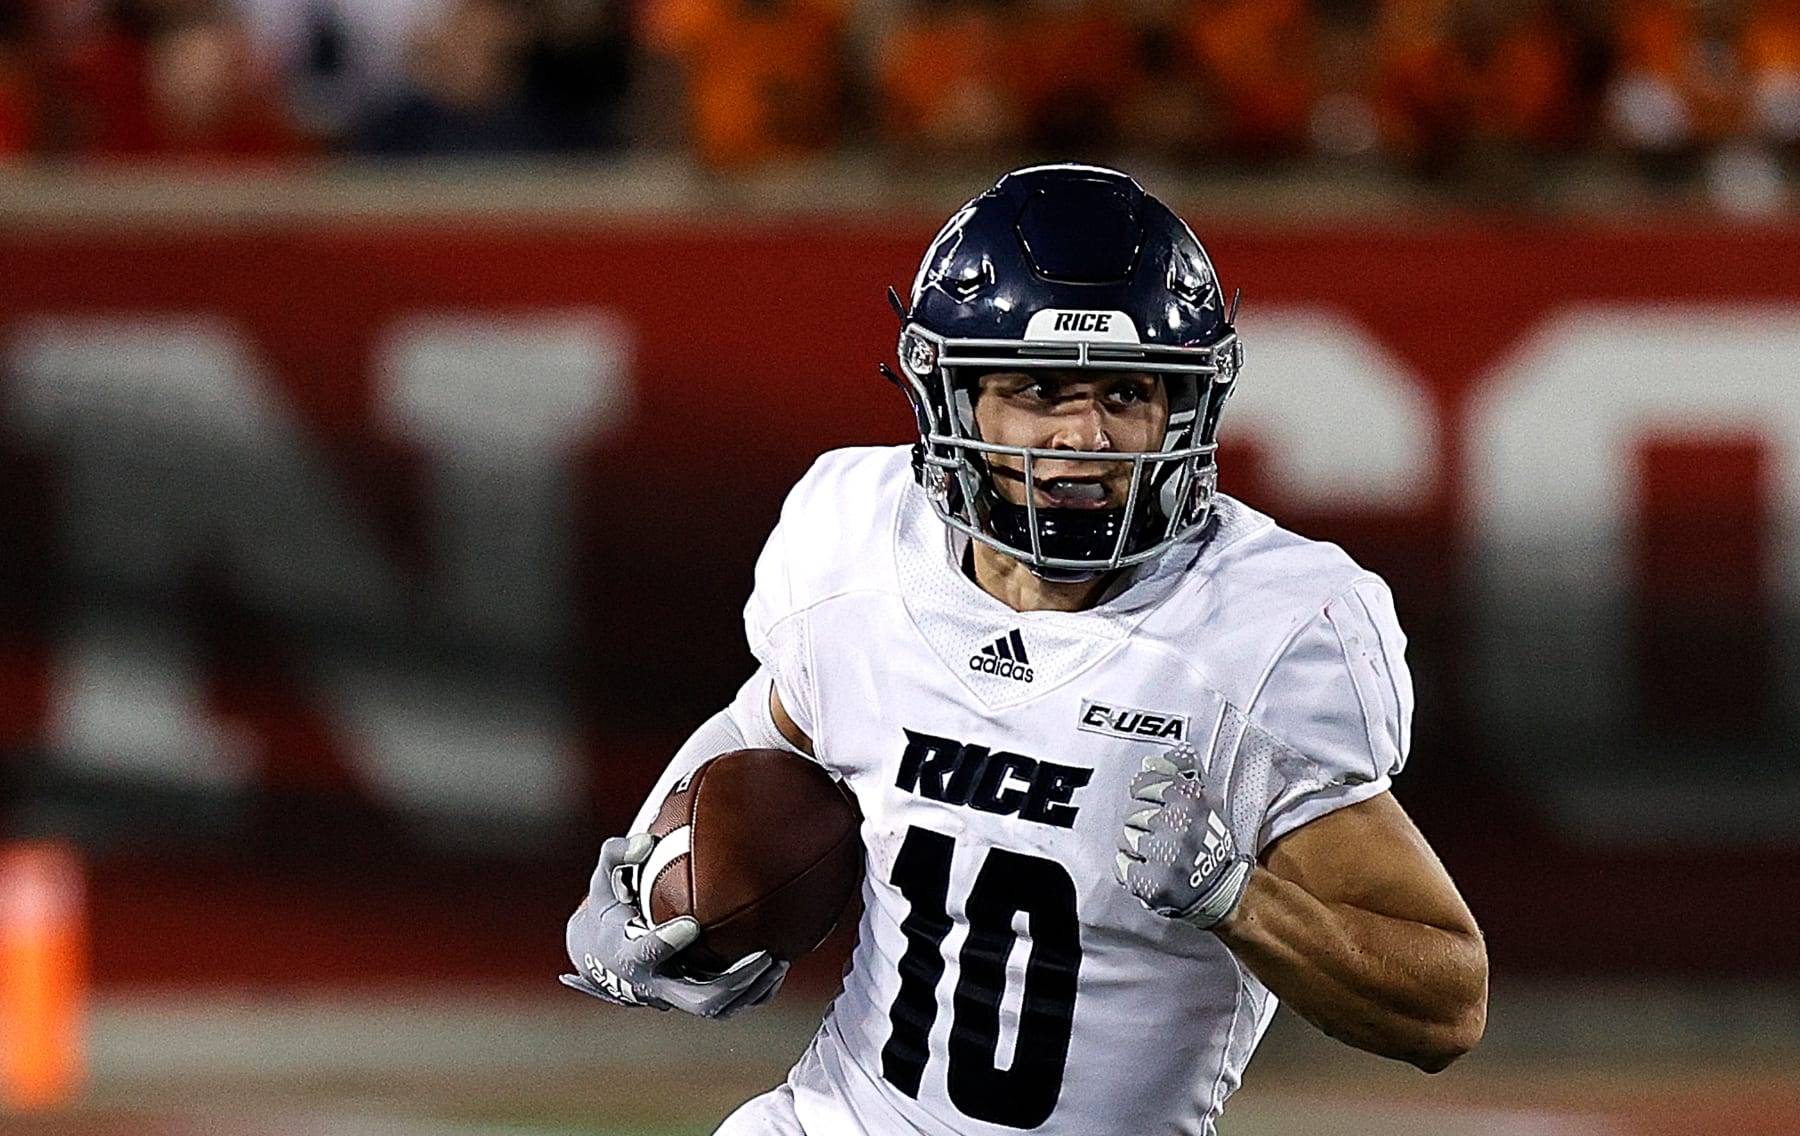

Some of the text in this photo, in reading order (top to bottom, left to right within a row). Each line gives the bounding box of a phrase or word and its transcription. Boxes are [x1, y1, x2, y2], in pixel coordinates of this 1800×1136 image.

[1054, 313, 1112, 332] RICE
[969, 655, 1034, 683] adidas
[895, 727, 1094, 829] RICE
[1189, 828, 1236, 888] adida
[881, 824, 1083, 1130] 10
